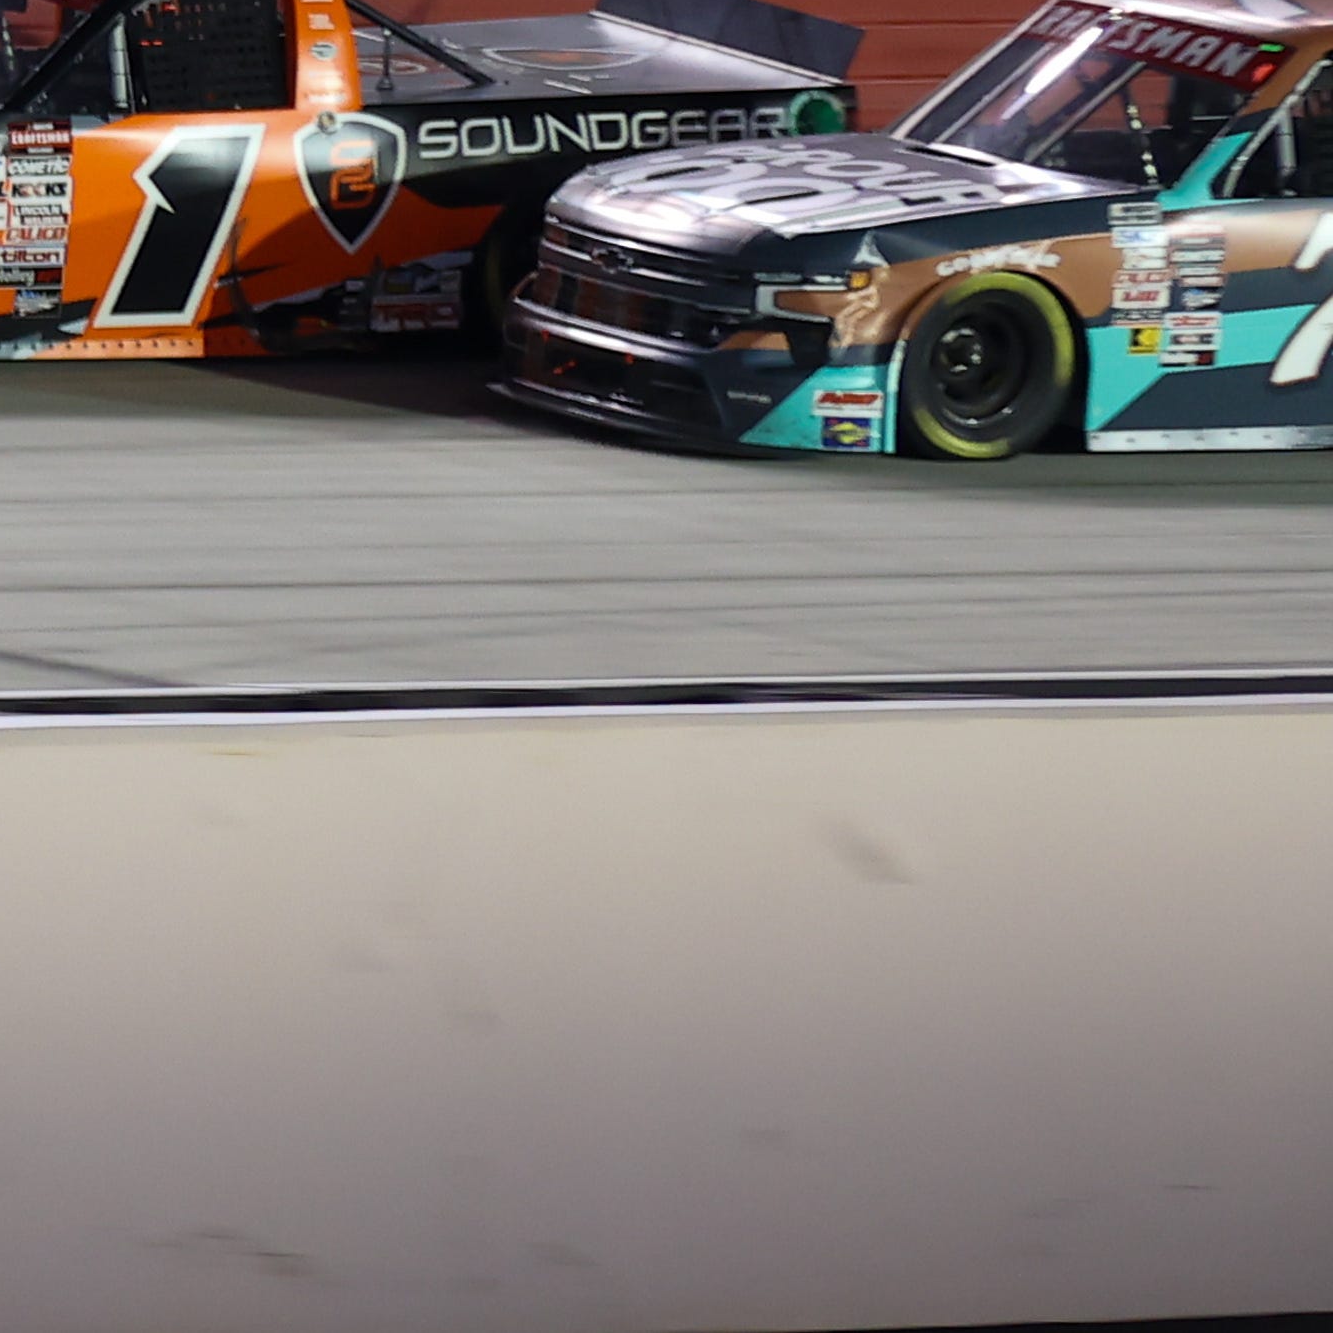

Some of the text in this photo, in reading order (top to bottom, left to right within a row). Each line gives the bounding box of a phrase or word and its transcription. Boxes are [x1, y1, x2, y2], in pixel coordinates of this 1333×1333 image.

[418, 108, 791, 159] SOUNDGEAR
[94, 125, 265, 327] 1
[0, 250, 60, 263] tilton
